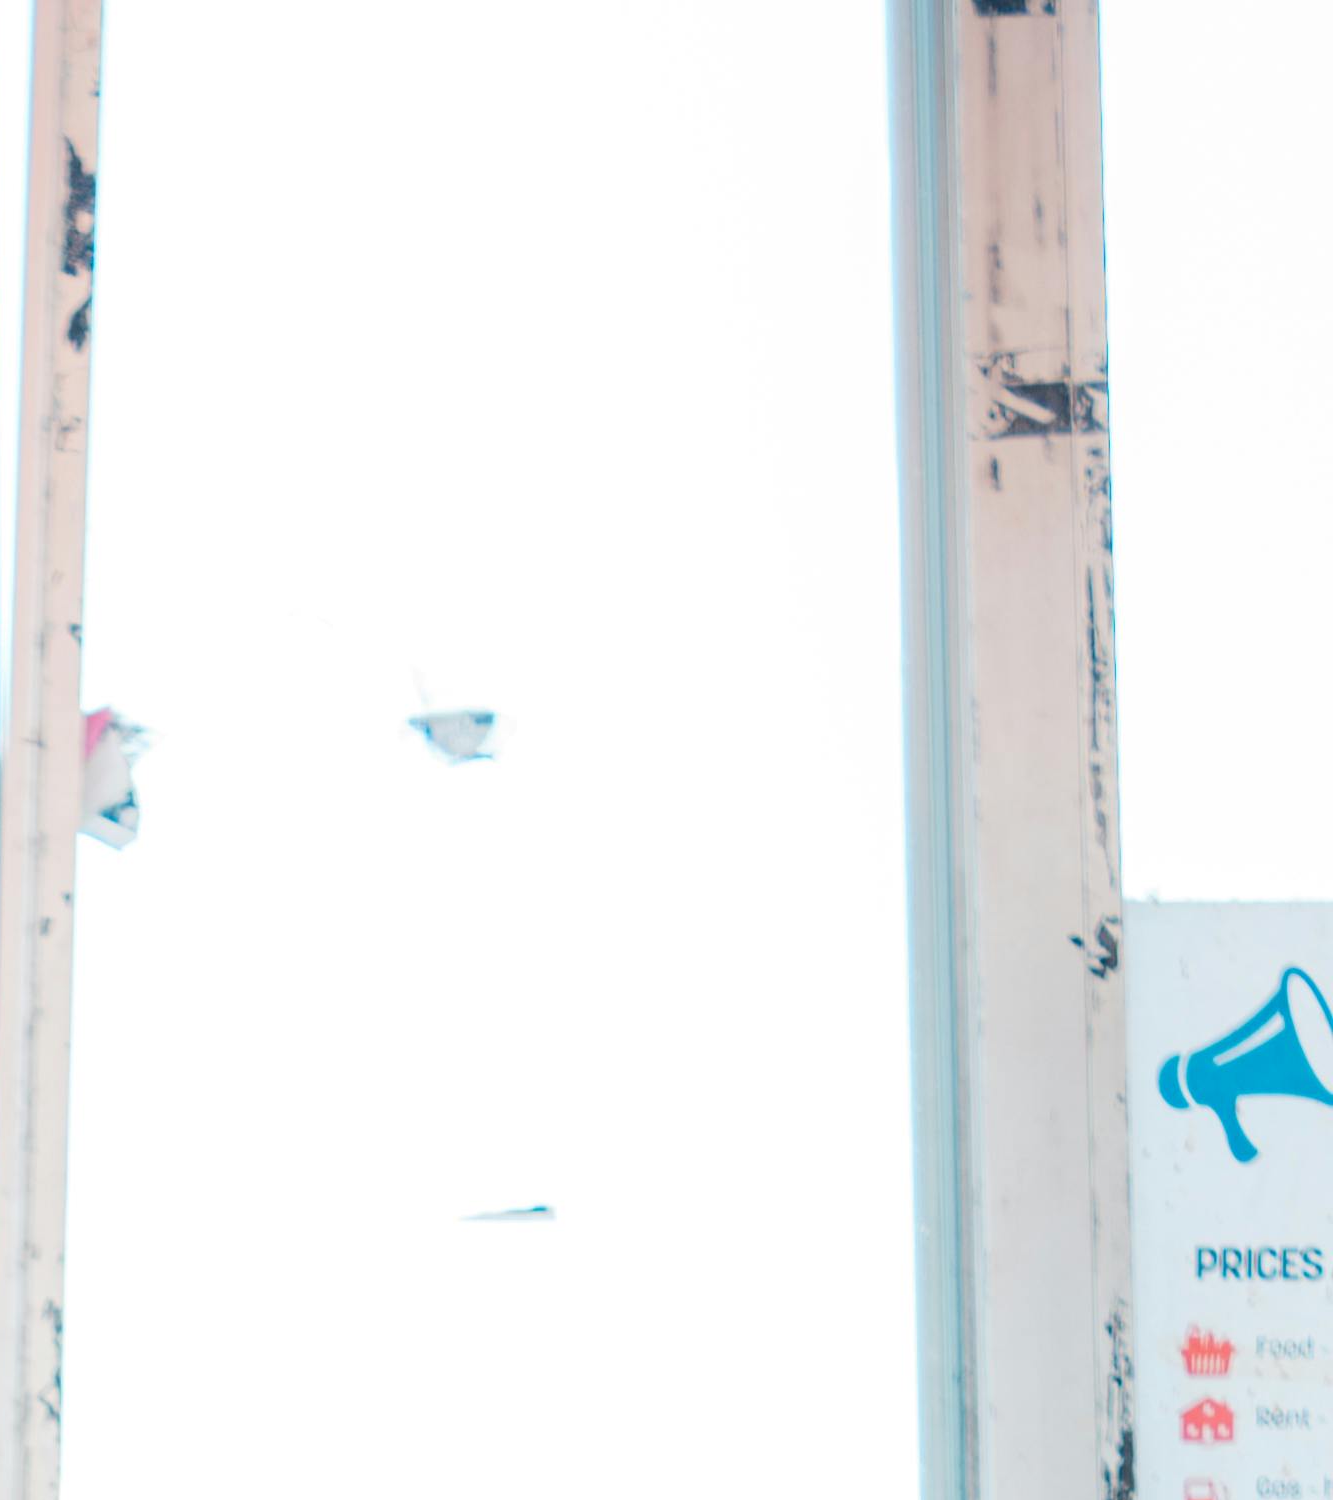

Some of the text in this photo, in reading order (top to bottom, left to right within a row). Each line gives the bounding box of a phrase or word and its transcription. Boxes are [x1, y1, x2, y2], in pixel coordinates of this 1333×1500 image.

[1195, 1246, 1324, 1281] PRICES
[1255, 1335, 1314, 1360] Food
[1255, 1405, 1311, 1430] Rent
